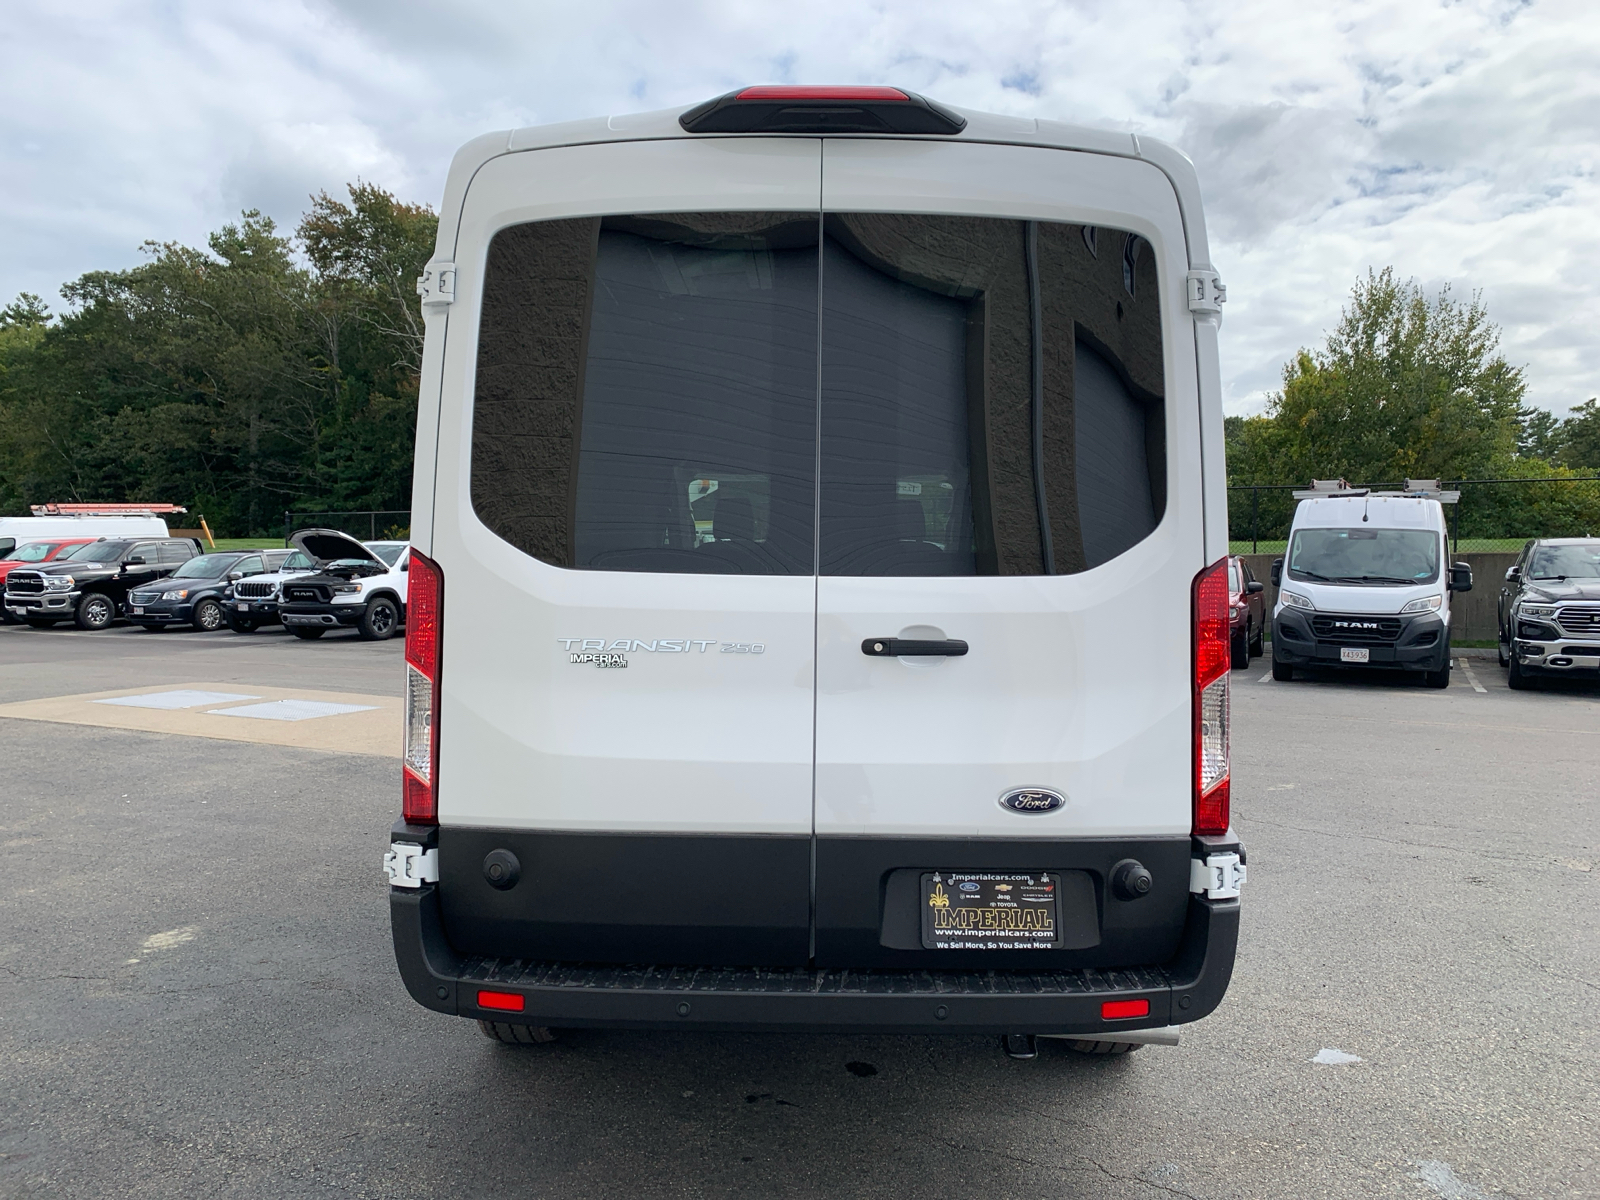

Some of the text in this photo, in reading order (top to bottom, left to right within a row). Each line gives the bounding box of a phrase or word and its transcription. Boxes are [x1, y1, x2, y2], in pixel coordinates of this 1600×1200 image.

[1335, 621, 1378, 629] RAM
[557, 637, 765, 654] TRANSIT 250
[570, 653, 627, 664] IMPERIAL
[1014, 793, 1052, 809] Ford
[952, 873, 1030, 881] Imperialcars.com
[935, 907, 1054, 930] IMPERIAL
[935, 928, 1054, 937] www.imperialcars.com
[965, 942, 986, 950] More,
